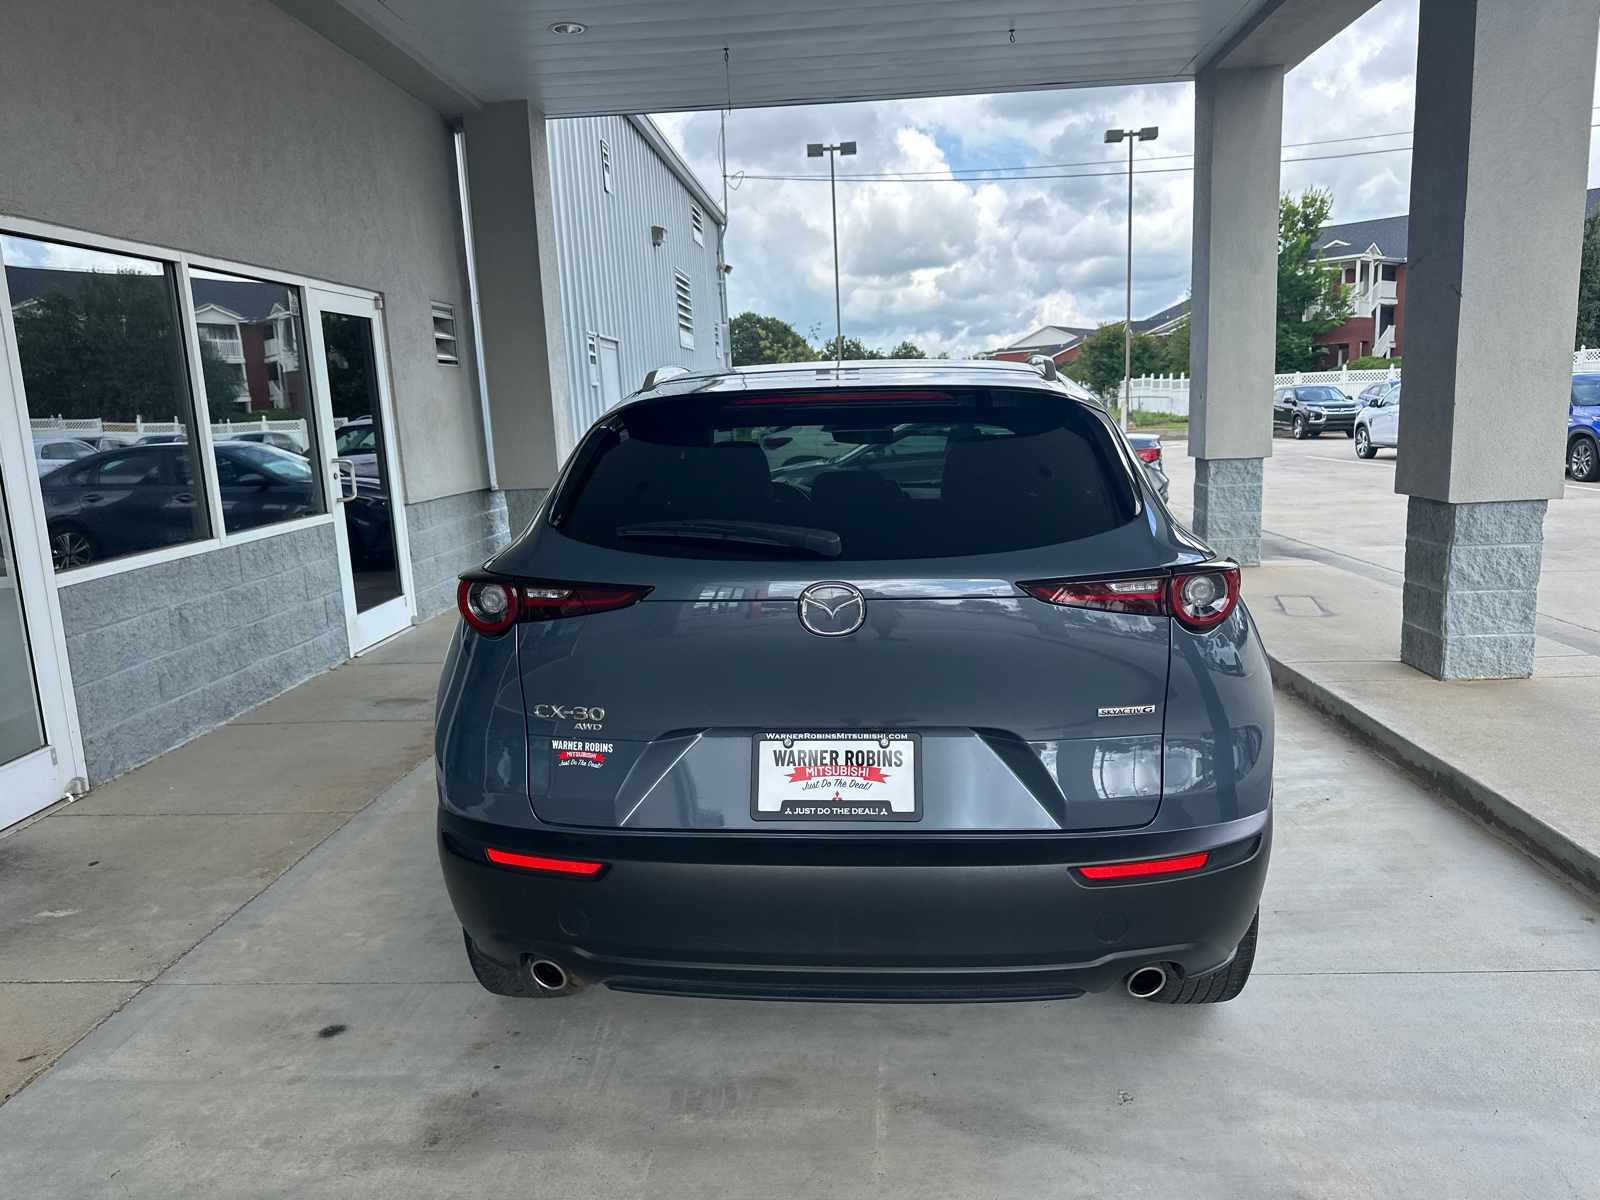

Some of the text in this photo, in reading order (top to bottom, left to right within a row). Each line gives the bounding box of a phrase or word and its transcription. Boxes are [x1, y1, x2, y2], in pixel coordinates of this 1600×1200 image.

[534, 704, 606, 721] CX-30
[574, 722, 602, 730] AWD
[552, 740, 613, 753] WARNER ROBINS
[566, 751, 597, 759] MITSUBISHI
[773, 750, 903, 767] WARNER ROBINS
[559, 759, 570, 767] Just
[587, 760, 603, 769] Deal!
[805, 767, 869, 777] MITSUBISHI
[802, 778, 873, 790] Just Do The Deal!
